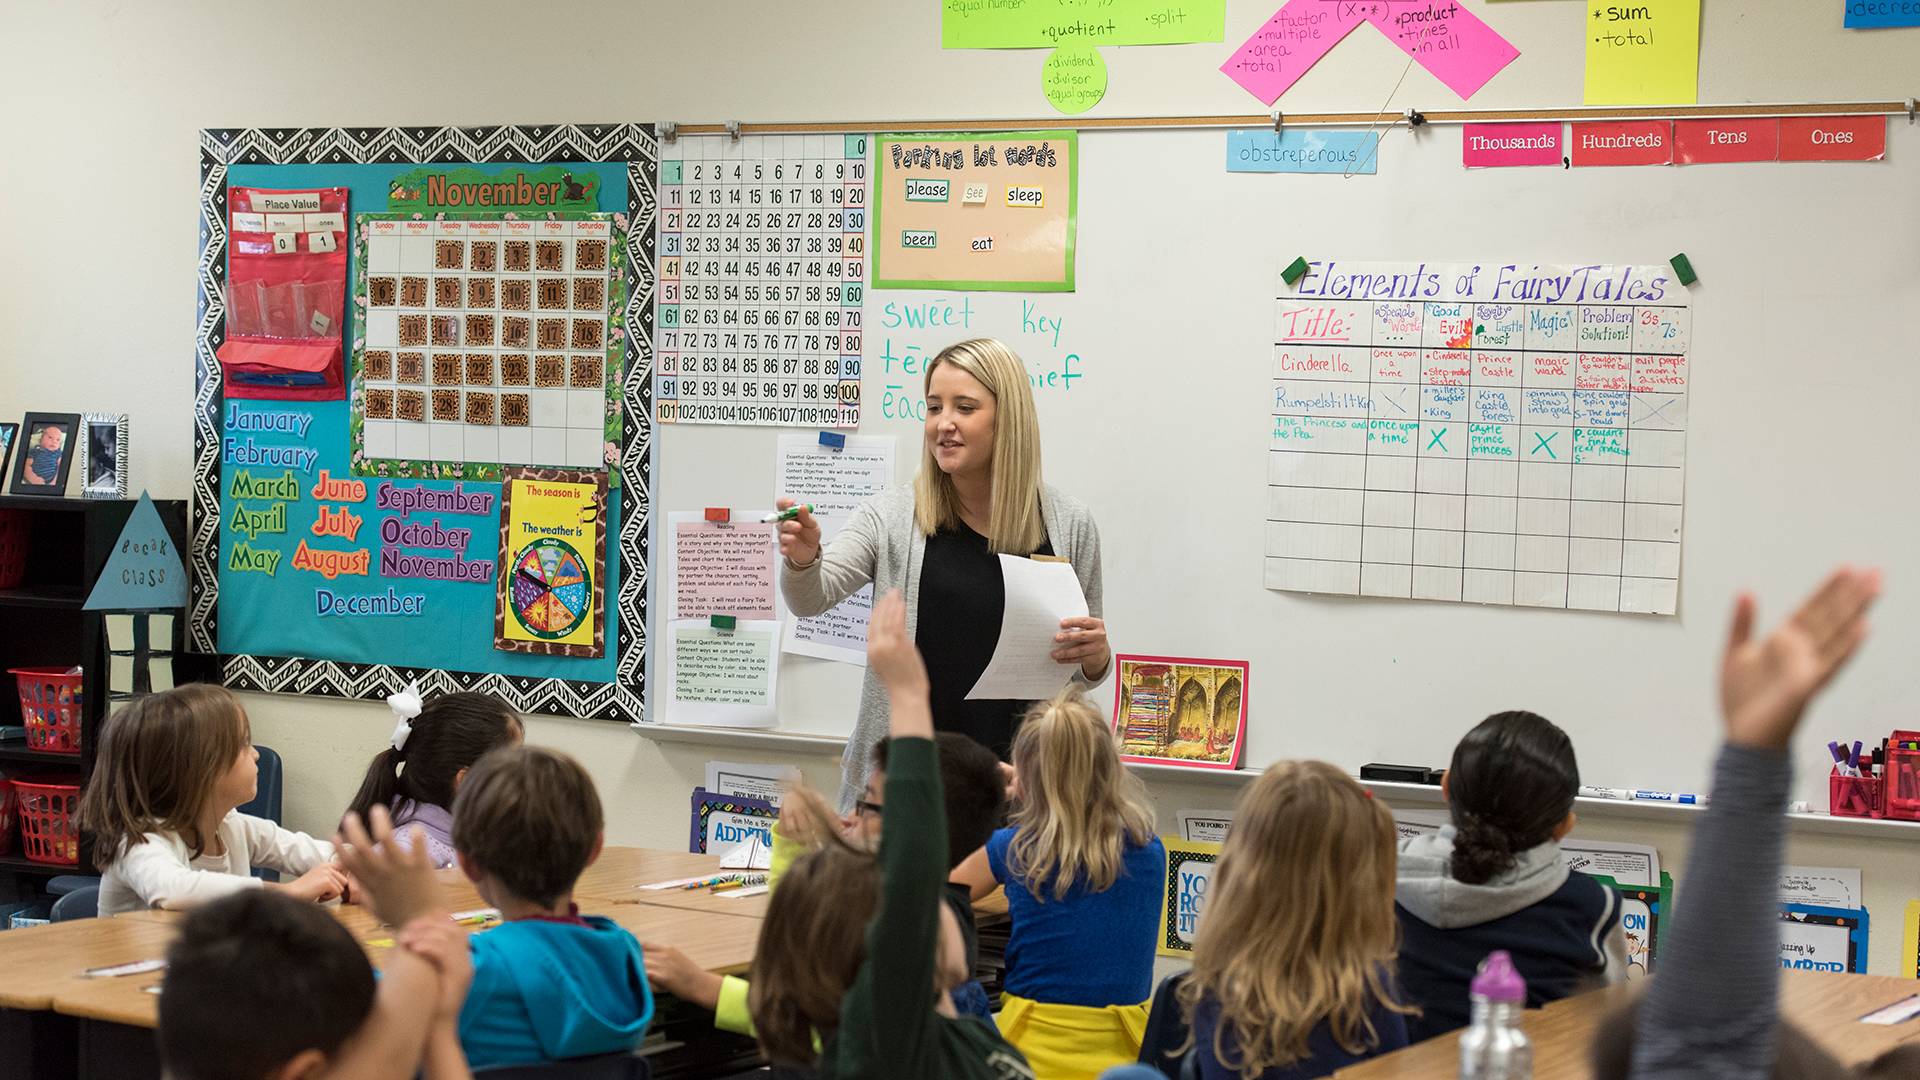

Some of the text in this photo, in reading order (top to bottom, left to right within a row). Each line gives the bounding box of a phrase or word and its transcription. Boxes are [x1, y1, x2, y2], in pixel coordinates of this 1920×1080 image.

[1151, 11, 1187, 26] split
[1279, 10, 1327, 26] factor
[1401, 5, 1457, 28] product
[1607, 5, 1652, 22] sum
[1049, 19, 1116, 42] quotient
[1265, 27, 1321, 42] multiple
[1405, 24, 1448, 39] times
[1602, 29, 1654, 47] total
[1254, 45, 1292, 56] area
[1053, 55, 1095, 68] dividend
[1242, 60, 1282, 72] total
[1053, 74, 1091, 85] divisor
[1051, 87, 1076, 102] equal
[858, 139, 866, 154] 0
[1470, 129, 1854, 151] Thousands Hundreds Tens Ones
[1240, 139, 1358, 169] obstreperous
[676, 164, 864, 180] 1 2 3 4 5 6 7 8 9 10
[427, 173, 561, 206] November
[906, 181, 947, 199] please
[1008, 187, 1043, 206] sleep
[265, 200, 318, 209] Place Value
[407, 222, 428, 230] Monday
[468, 222, 500, 230] Wednesday
[506, 222, 531, 230] Thursday
[544, 222, 563, 230] Friday
[577, 222, 606, 230] Saturday
[319, 236, 327, 247] 1
[904, 232, 935, 247] been
[971, 236, 993, 250] eat
[1299, 261, 1441, 299] Elements
[1455, 264, 1481, 297] of
[1432, 304, 1461, 317] Good
[1583, 307, 1633, 324] Problem
[1439, 320, 1464, 335] Evil
[1529, 308, 1568, 338] Magic
[1281, 353, 1353, 373] Cinderella
[663, 380, 860, 400] 91 92 93 94 95 96 97 98 99 100
[225, 404, 311, 438] January
[224, 439, 317, 472] February
[231, 472, 491, 516] March June September
[526, 485, 580, 498] The season is
[231, 504, 469, 548] April July October
[522, 523, 582, 536] The weather is
[231, 543, 492, 580] May August November
[317, 588, 424, 615] December
